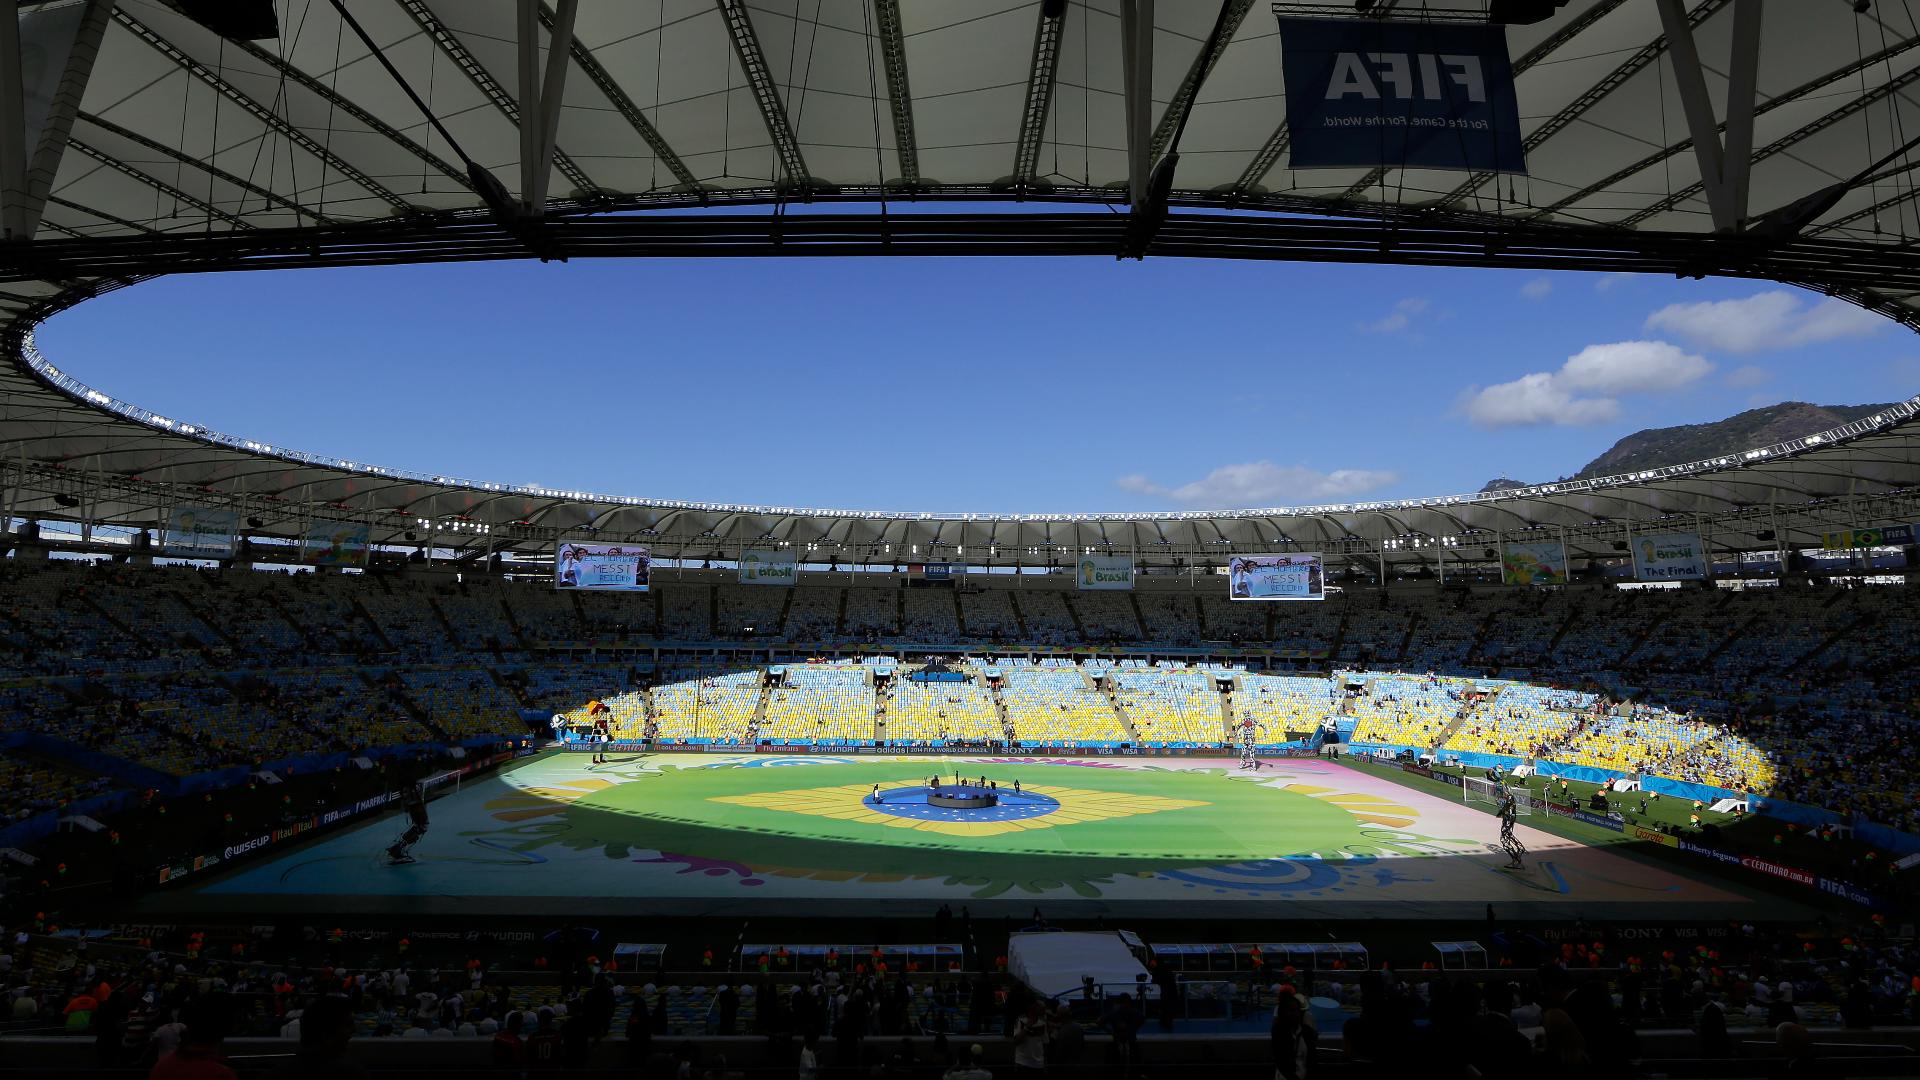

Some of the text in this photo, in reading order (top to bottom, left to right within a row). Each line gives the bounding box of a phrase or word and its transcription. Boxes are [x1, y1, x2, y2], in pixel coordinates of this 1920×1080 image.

[1886, 530, 1907, 539] FIFA
[1644, 565, 1697, 576] The Final
[1095, 571, 1129, 582] Brasil
[877, 746, 905, 754] adidas
[1433, 772, 1444, 781] VISA
[1447, 776, 1459, 786] VISA
[1687, 842, 1740, 863] Liberty Seguros
[1616, 928, 1664, 939] SONY
[1675, 928, 1698, 938] VISA
